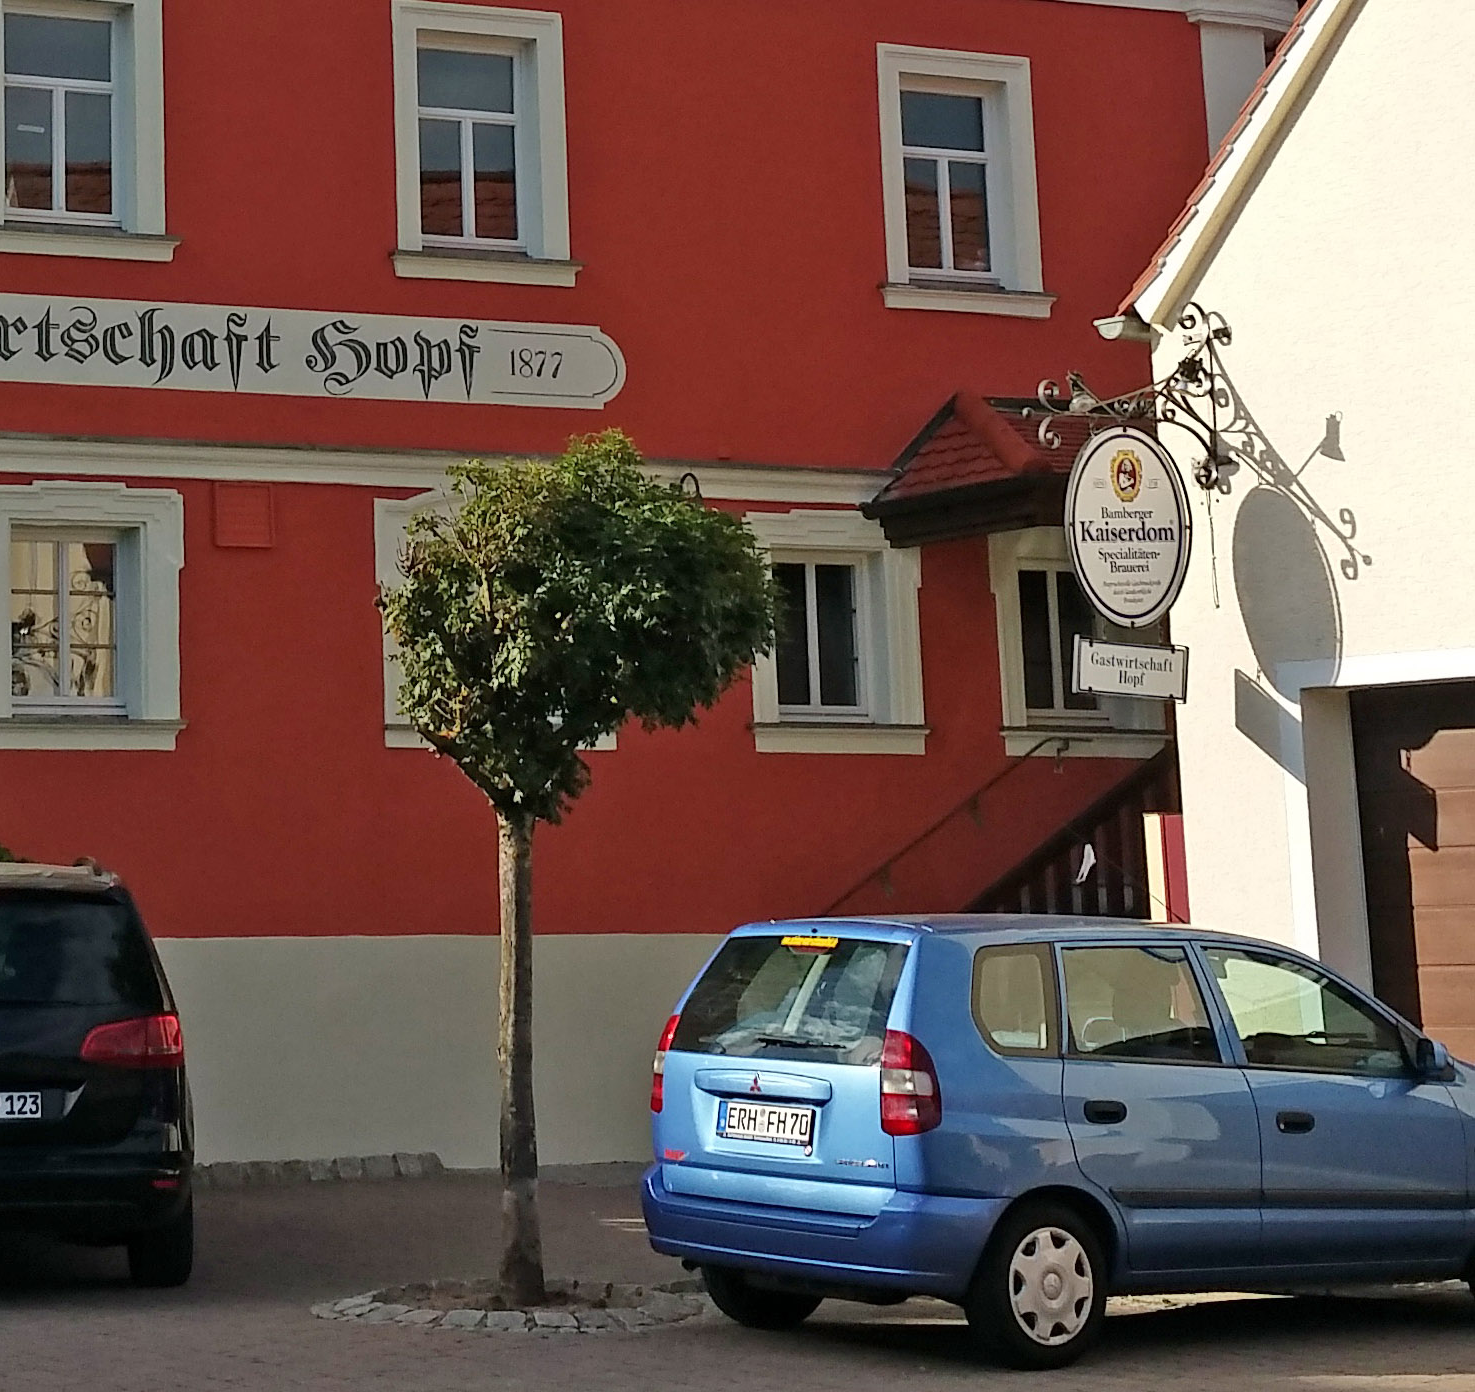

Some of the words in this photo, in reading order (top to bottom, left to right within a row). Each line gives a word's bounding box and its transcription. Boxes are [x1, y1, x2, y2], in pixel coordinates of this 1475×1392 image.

[305, 319, 482, 400] Hopf
[509, 347, 564, 379] 1877
[1101, 506, 1154, 522] Bamberger
[1079, 519, 1175, 543] Kaiserdom
[1098, 547, 1161, 563] Specialitäten-
[1110, 560, 1150, 574] Brauerei
[1090, 651, 1174, 673] Gastwirtschaft
[1118, 669, 1146, 688] Hopf
[5, 1094, 41, 1116] 123
[727, 1106, 758, 1132] ERH
